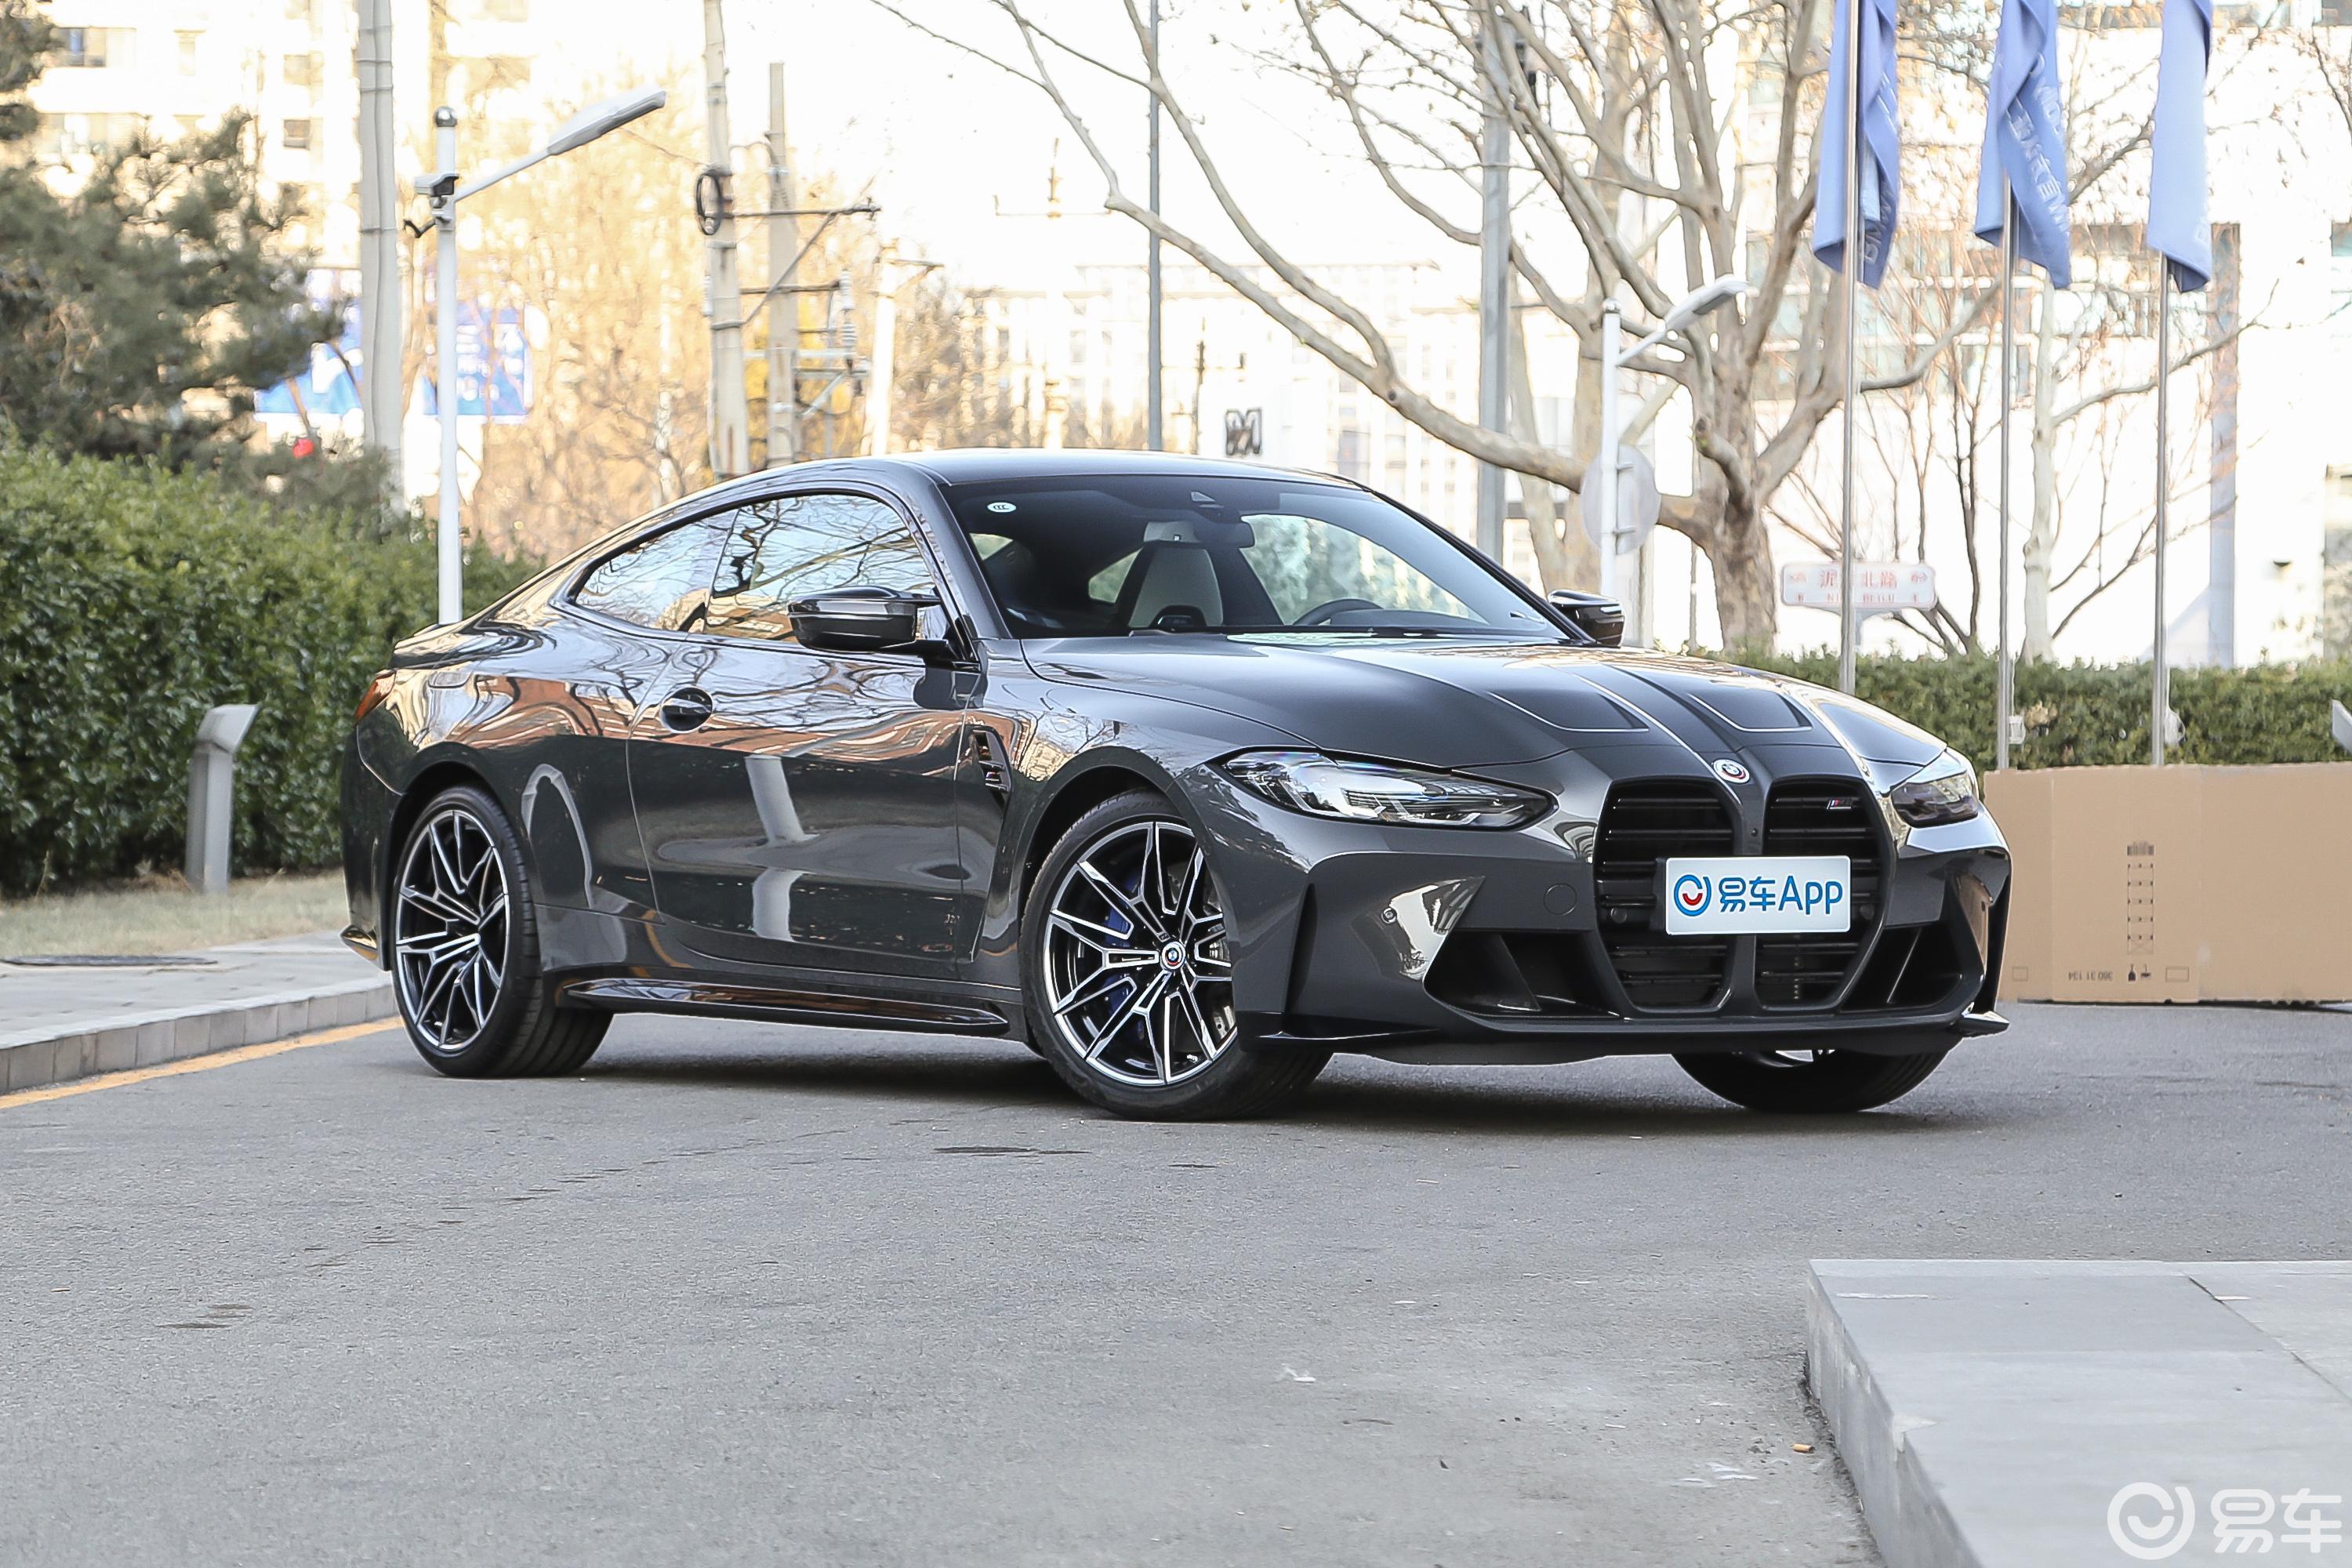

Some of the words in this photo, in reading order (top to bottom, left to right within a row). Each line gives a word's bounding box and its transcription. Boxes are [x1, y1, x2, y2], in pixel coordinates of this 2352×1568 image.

[1820, 569, 1897, 588] 泥北路
[1719, 875, 1843, 915] 易车App
